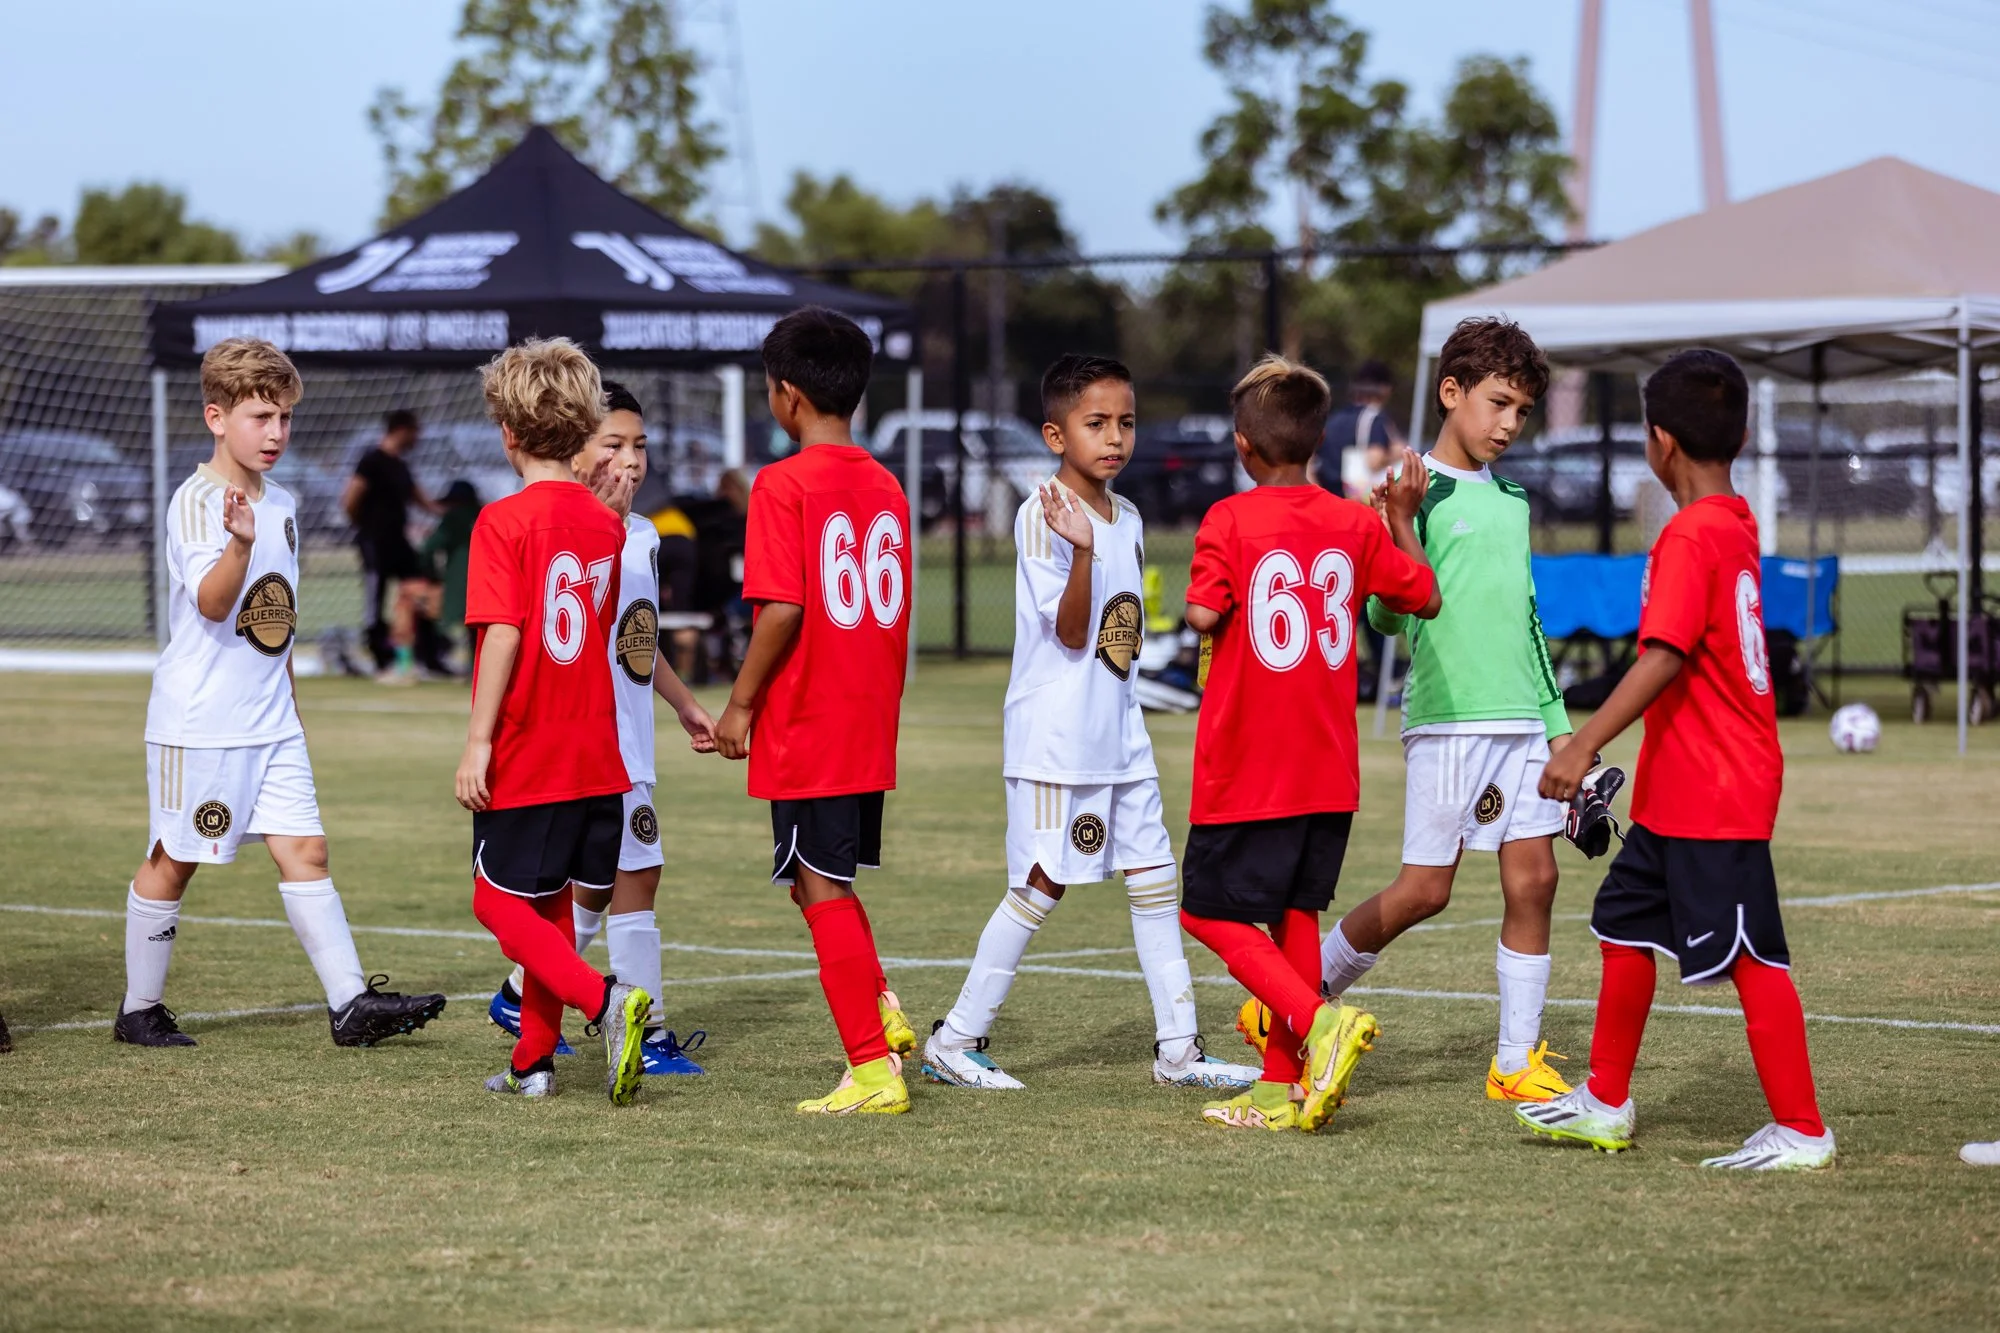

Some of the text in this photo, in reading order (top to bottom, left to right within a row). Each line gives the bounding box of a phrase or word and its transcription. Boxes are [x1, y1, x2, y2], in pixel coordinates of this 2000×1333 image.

[542, 551, 614, 665] 67
[820, 510, 904, 629] 66
[1248, 548, 1354, 672] 63
[617, 636, 655, 651] GUERRE
